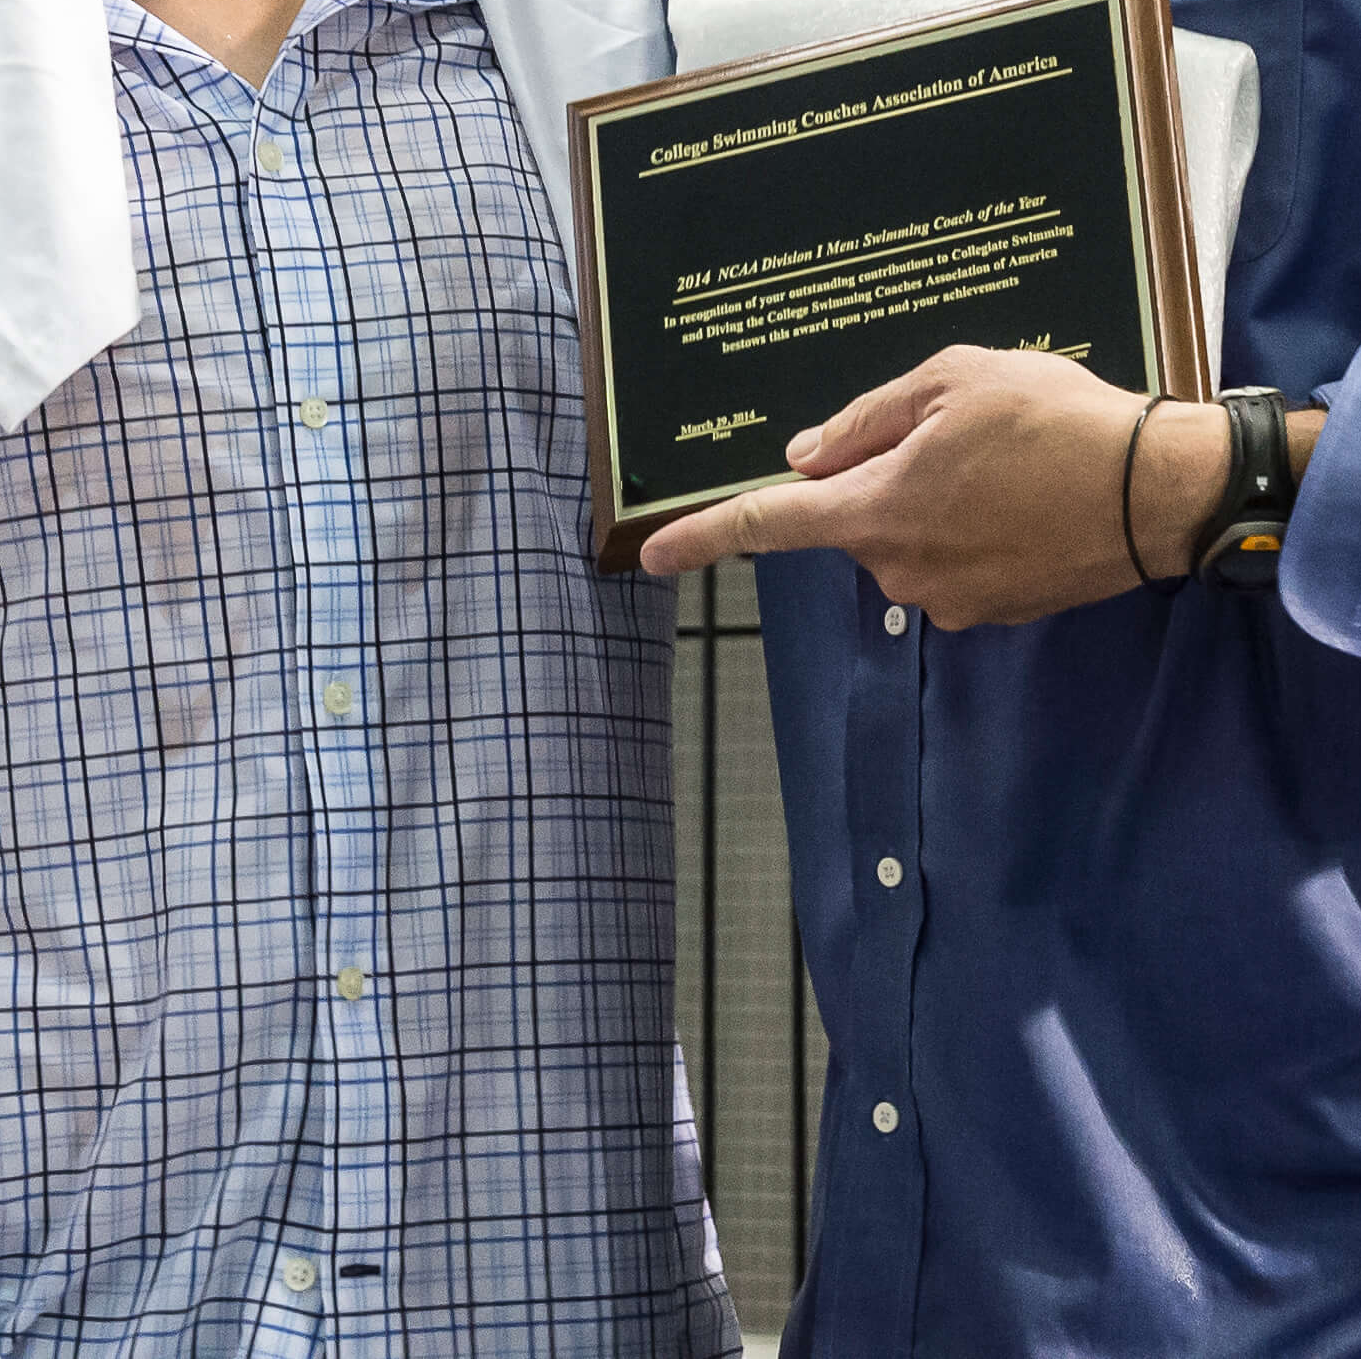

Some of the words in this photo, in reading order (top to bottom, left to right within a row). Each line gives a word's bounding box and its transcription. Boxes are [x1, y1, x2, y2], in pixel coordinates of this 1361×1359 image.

[649, 139, 708, 166] College
[712, 119, 798, 151] Swimming
[801, 100, 868, 129] Coaches
[872, 78, 964, 111] Association
[967, 68, 985, 88] of
[989, 55, 1059, 83] America
[663, 315, 677, 330] In
[679, 301, 742, 326] recognition
[745, 295, 758, 310] of
[758, 290, 787, 310] your
[788, 274, 856, 299] outstanding
[857, 256, 934, 283] contributions
[937, 252, 949, 265] to
[951, 239, 1009, 262] Collegiate
[1011, 224, 1074, 248] Swimming
[676, 269, 712, 293] 2014
[717, 259, 759, 282] NCAA
[761, 249, 813, 272] Division
[816, 244, 824, 259] I
[862, 221, 930, 248] Swimming
[933, 209, 974, 231] Coach
[977, 204, 993, 223] of
[994, 200, 1015, 217] the
[1018, 194, 1048, 211] Year
[681, 329, 704, 345] and
[706, 320, 744, 339] Diving
[746, 314, 765, 328] the
[767, 305, 809, 323] College
[811, 291, 873, 313] Swimming
[874, 278, 923, 299] Coaches
[925, 263, 991, 288] Association
[993, 257, 1006, 271] of
[1008, 247, 1059, 268] America
[721, 333, 767, 354] bestows
[769, 327, 790, 343] this
[792, 318, 830, 338] award
[831, 312, 861, 330] upon
[863, 307, 885, 324] you
[887, 299, 910, 316] and
[912, 294, 940, 312] your
[942, 275, 1020, 303] achievements
[680, 418, 714, 436] March
